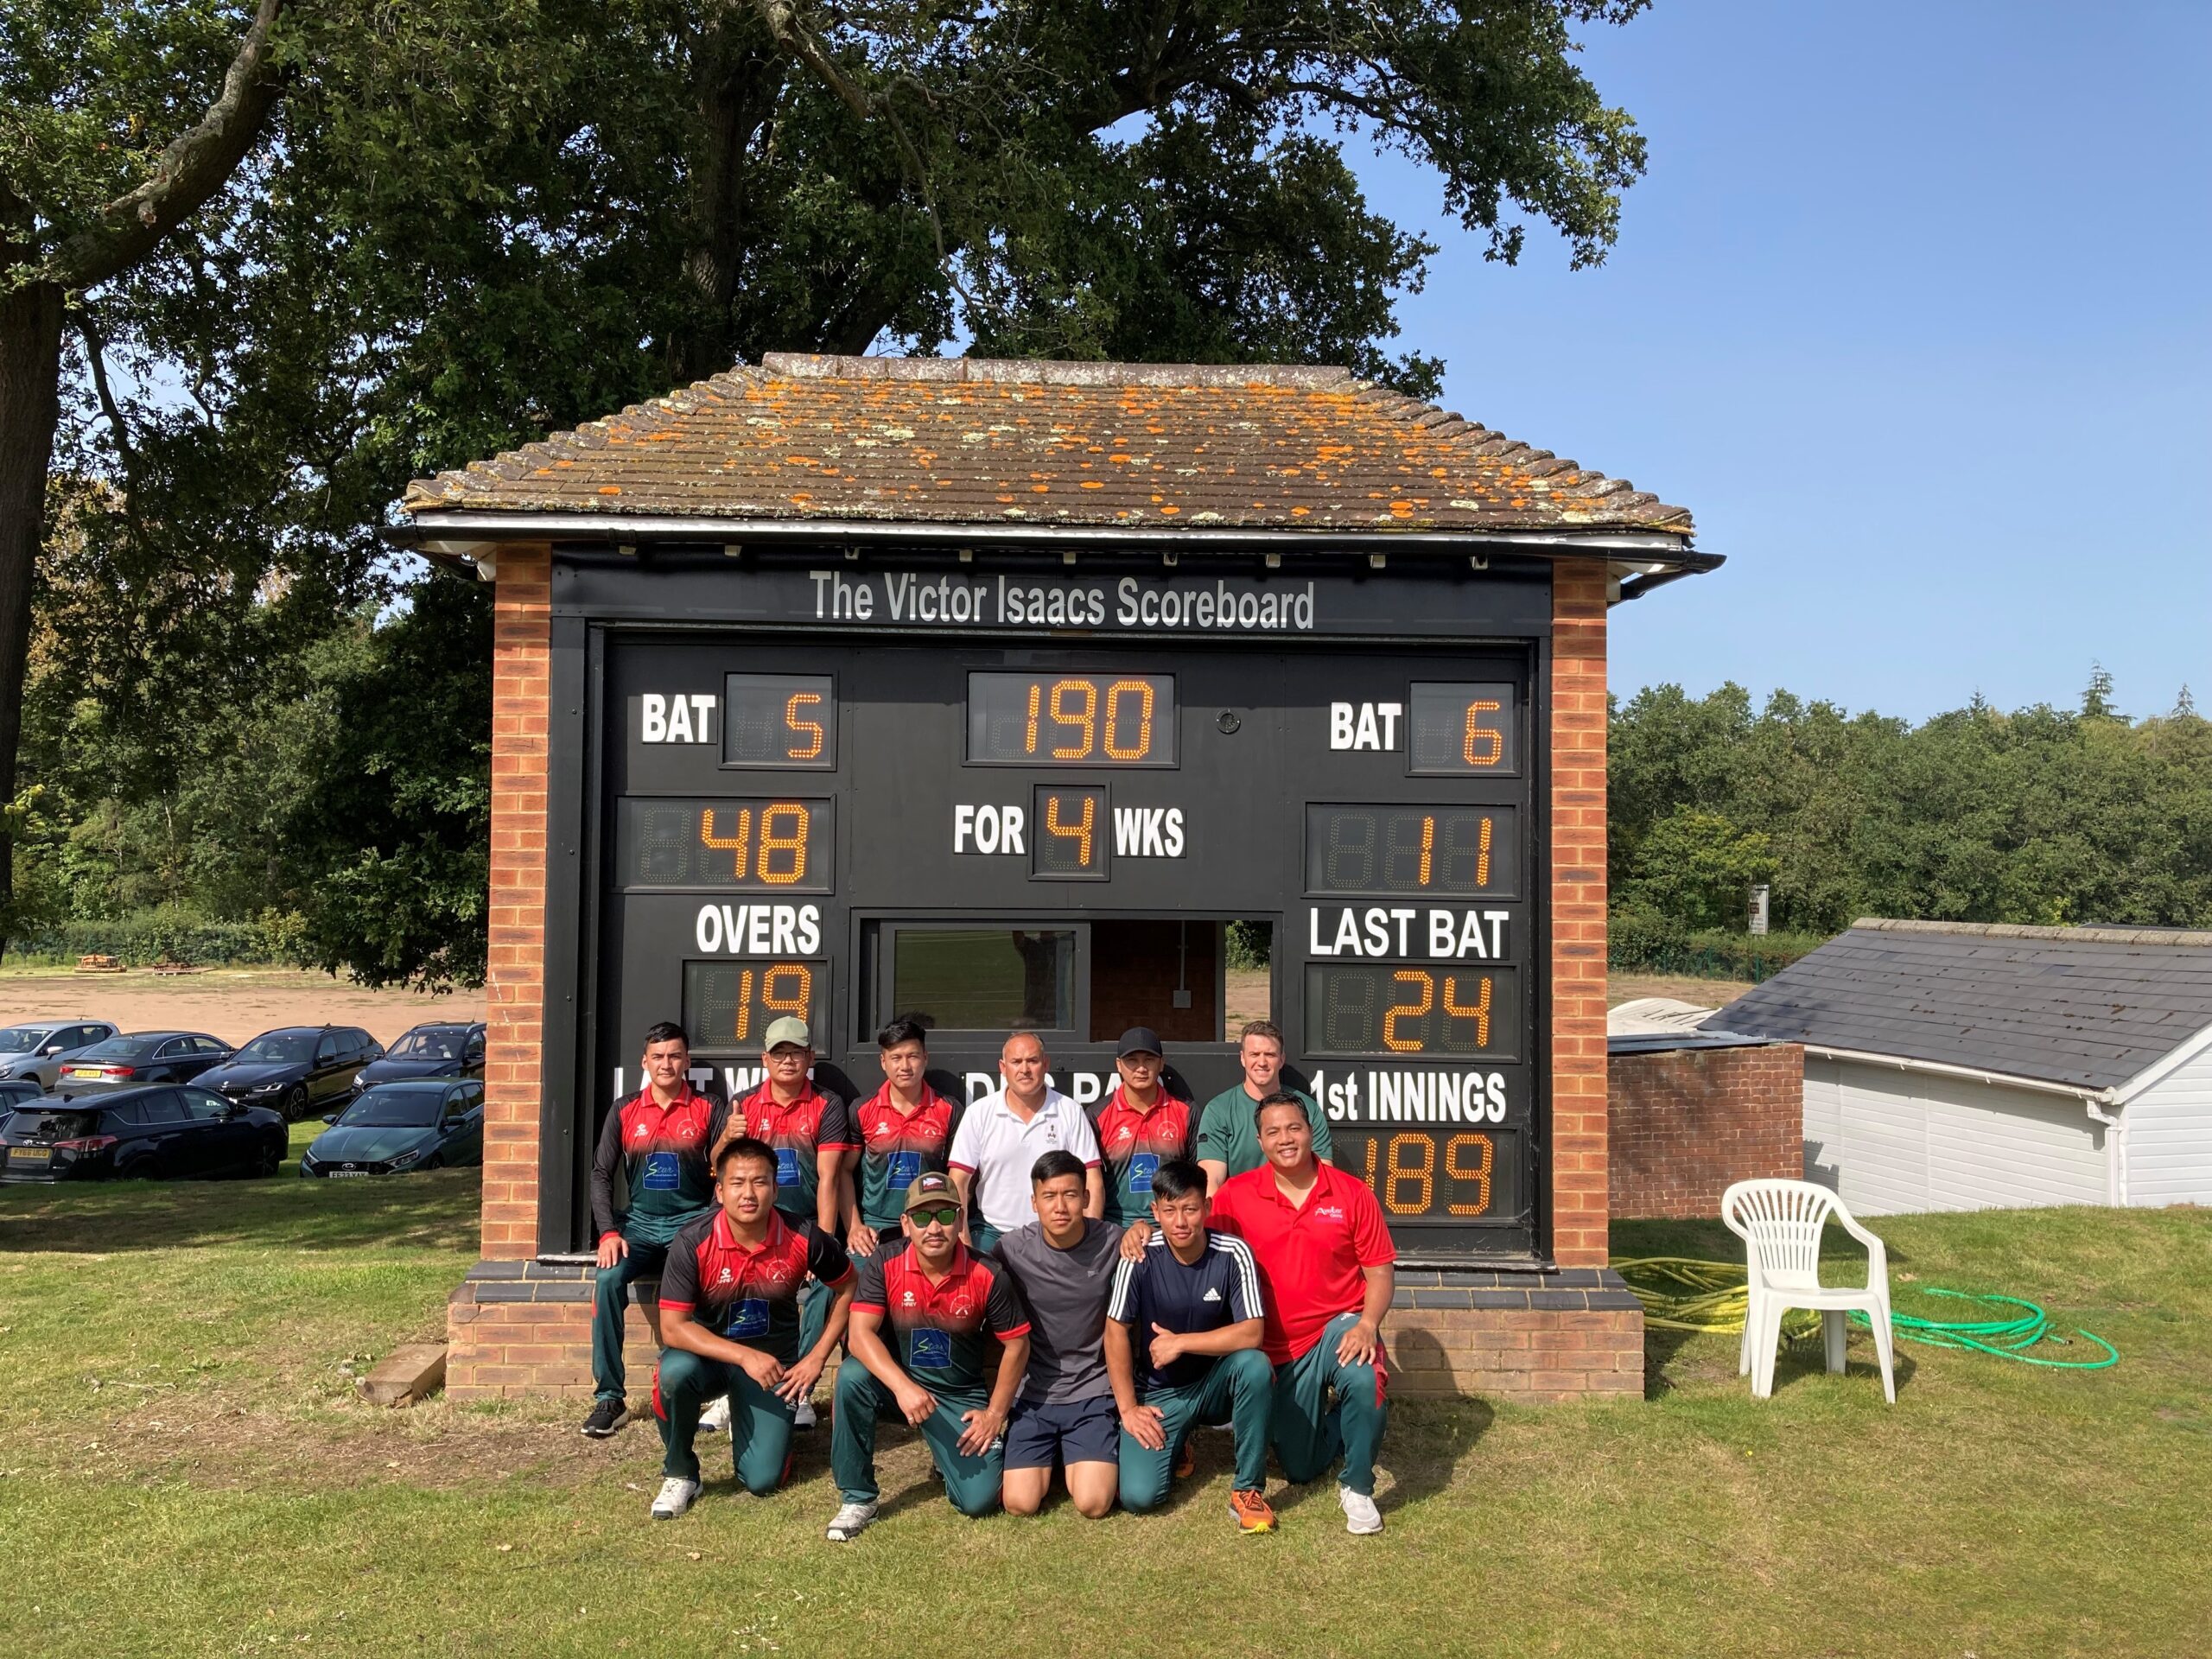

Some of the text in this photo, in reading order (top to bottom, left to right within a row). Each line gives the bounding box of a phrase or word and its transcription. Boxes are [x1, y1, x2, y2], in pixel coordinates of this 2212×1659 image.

[810, 571, 1314, 629] The Victor Isaacs Scoreboard
[642, 694, 715, 743] BAT
[785, 693, 823, 759] 5
[1026, 679, 1154, 760] 190
[1330, 702, 1402, 751] BAT
[1464, 701, 1503, 766] 6
[701, 804, 809, 884] 48
[954, 804, 1025, 855] FOR
[1046, 797, 1094, 866] 4
[1114, 807, 1184, 857] WKS
[1420, 817, 1491, 887] 11
[696, 904, 820, 955] OVERS
[1310, 907, 1510, 959] LAST BAT
[737, 965, 811, 1039] 19
[1383, 970, 1491, 1051] 24
[1310, 1070, 1506, 1123] 1st INNINGS
[1365, 1134, 1493, 1215] 189
